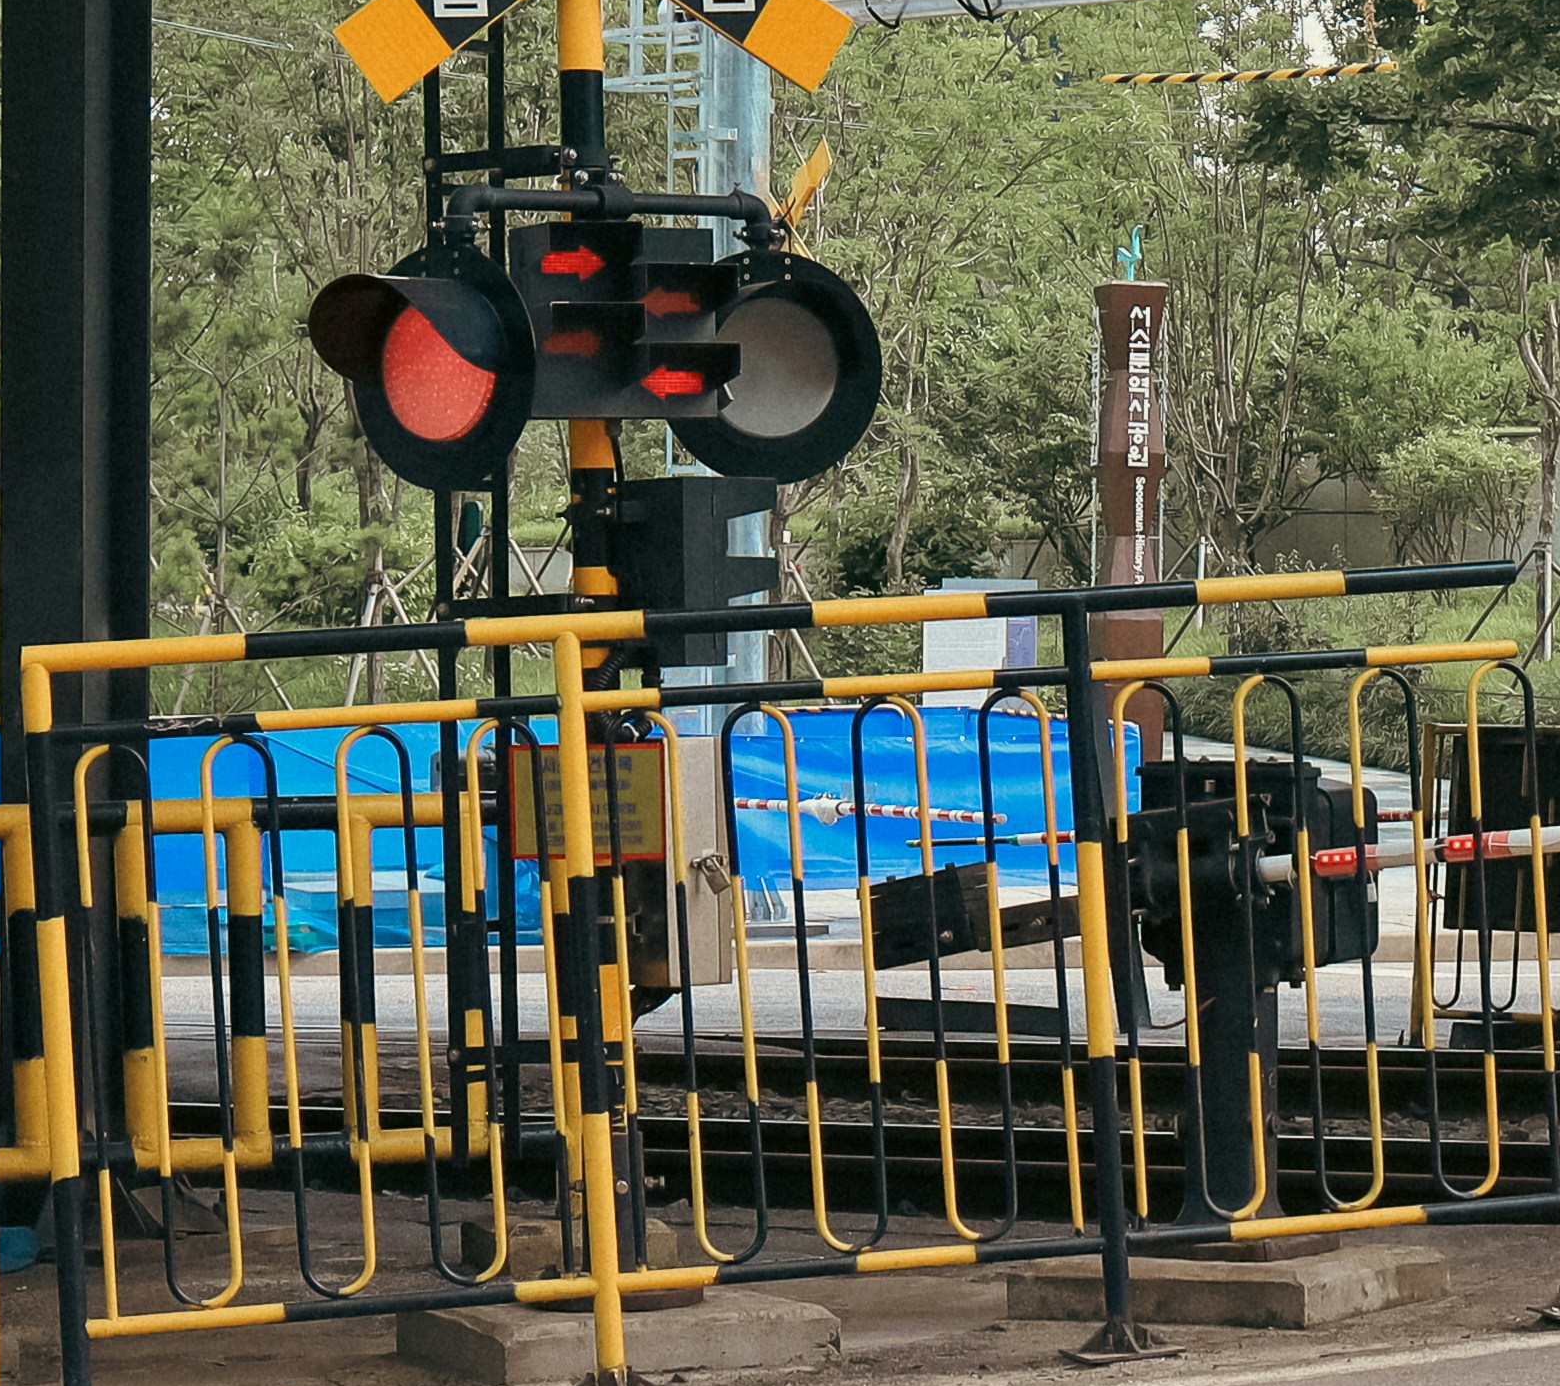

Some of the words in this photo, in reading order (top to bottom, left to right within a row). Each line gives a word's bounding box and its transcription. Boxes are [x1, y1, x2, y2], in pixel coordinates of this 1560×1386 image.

[1127, 305, 1151, 468] 서소문역사공원
[1134, 476, 1146, 532] Seosomun
[1133, 534, 1146, 574] History
